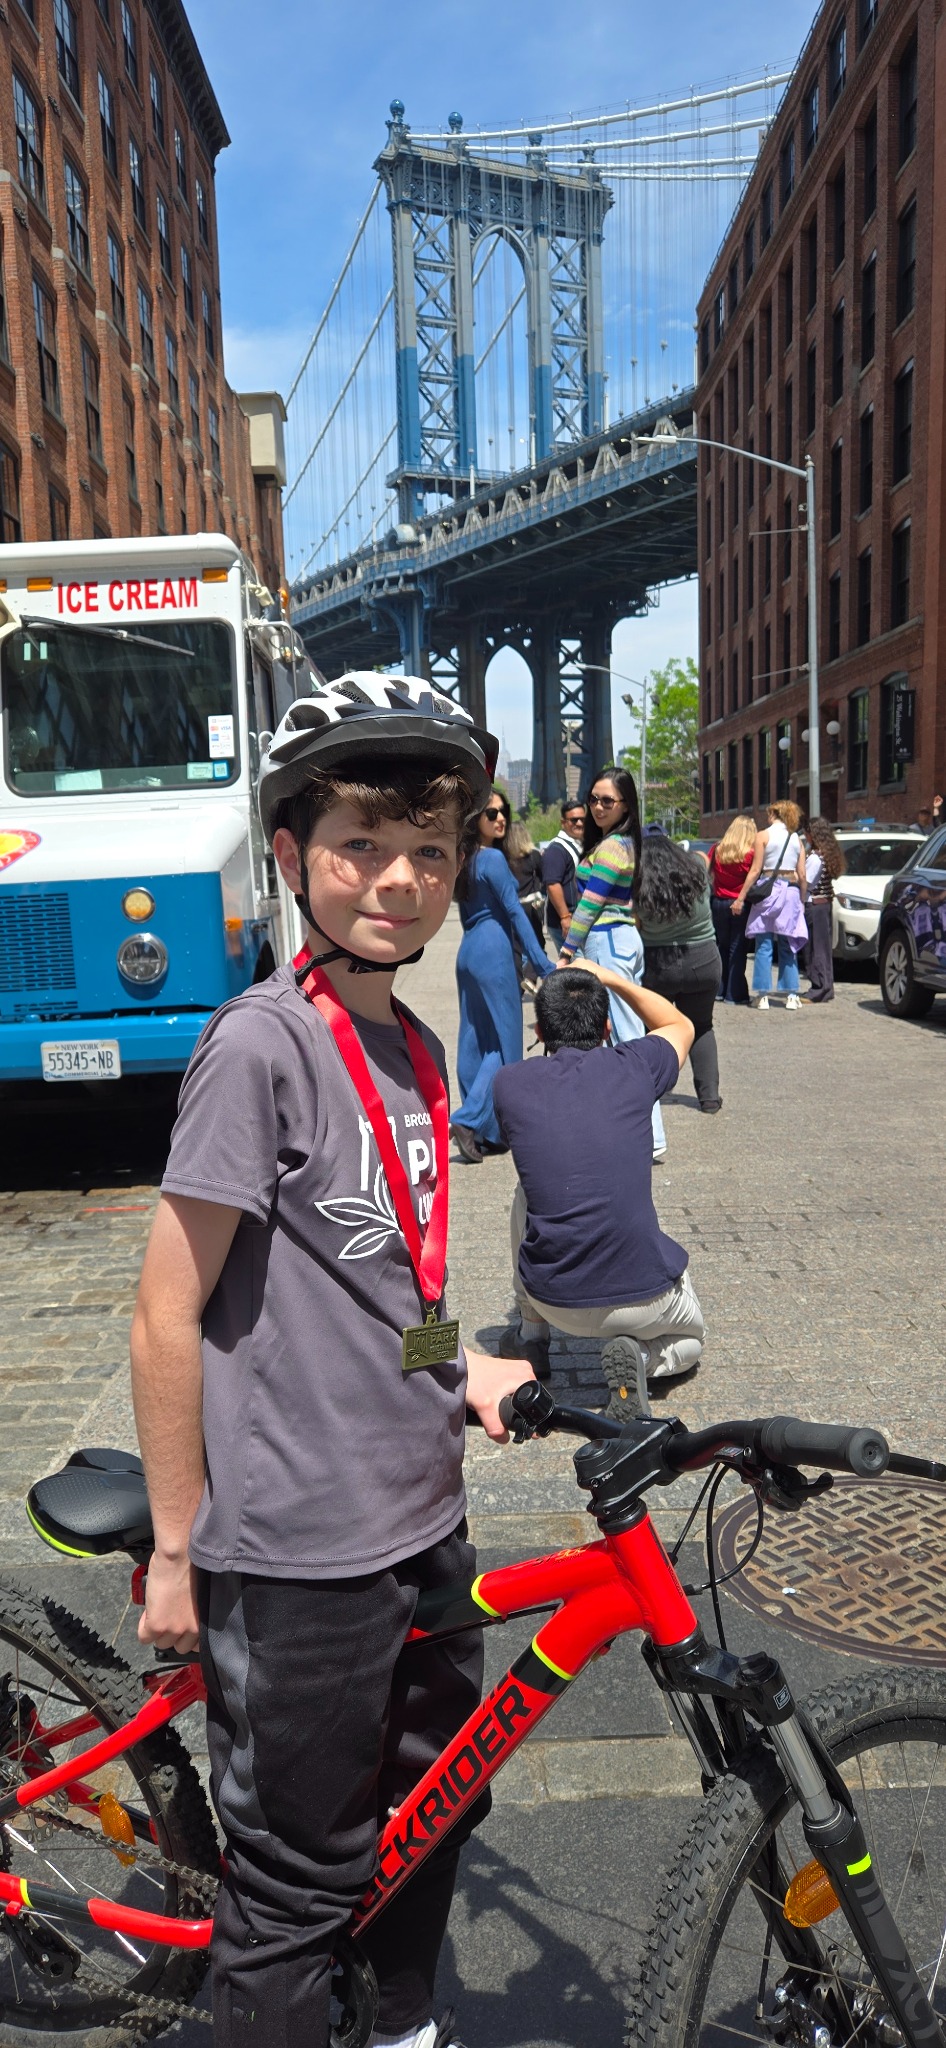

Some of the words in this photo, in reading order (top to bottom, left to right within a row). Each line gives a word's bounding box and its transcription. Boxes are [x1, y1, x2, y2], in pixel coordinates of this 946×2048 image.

[57, 581, 99, 614] ICE
[108, 576, 198, 612] CREAM
[430, 1330, 457, 1345] PARK
[352, 1684, 533, 1924] OCKRIDER
